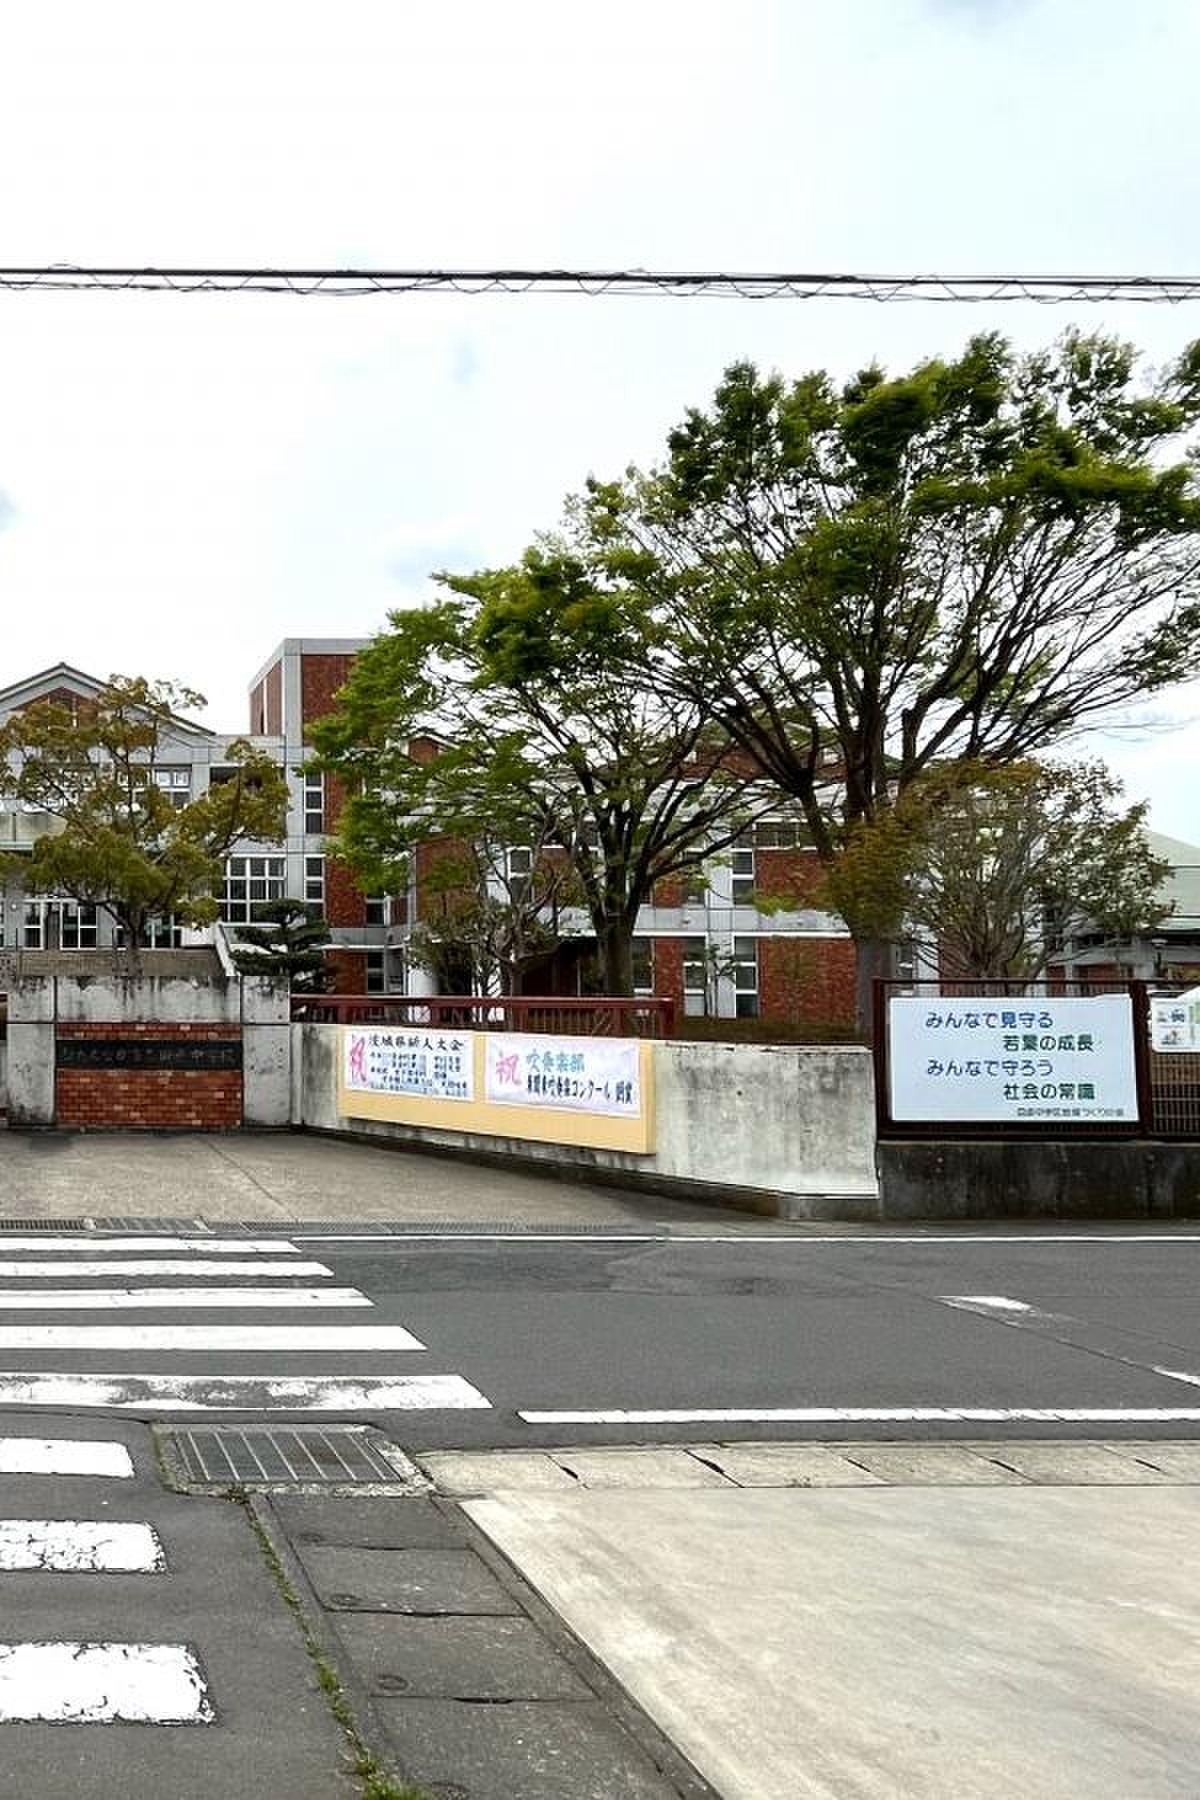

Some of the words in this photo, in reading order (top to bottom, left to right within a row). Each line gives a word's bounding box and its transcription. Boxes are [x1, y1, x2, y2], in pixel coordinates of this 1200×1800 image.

[925, 1011, 1054, 1029] みんなで見守る
[1002, 1034, 1094, 1052] 若葉の成長
[495, 1051, 522, 1085] 祝
[927, 1059, 1054, 1077] みんなで守ろう
[1003, 1083, 1096, 1100] 社会の常識
